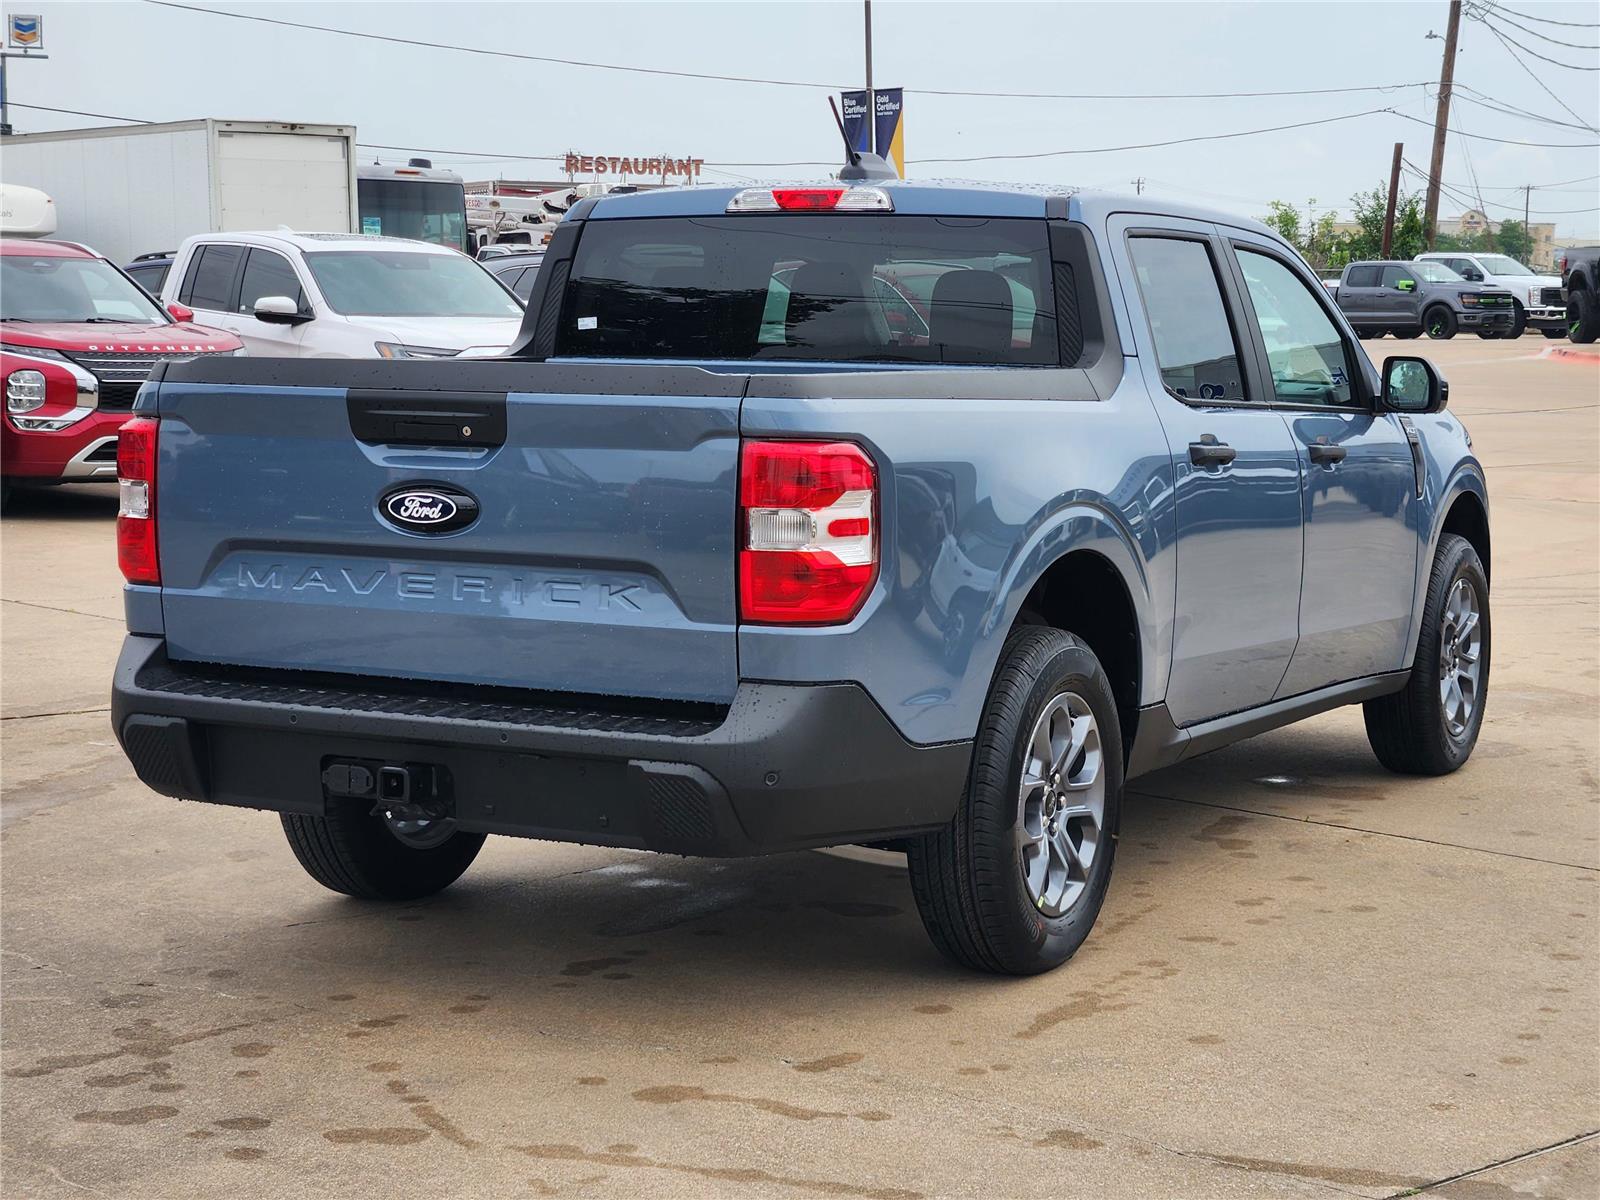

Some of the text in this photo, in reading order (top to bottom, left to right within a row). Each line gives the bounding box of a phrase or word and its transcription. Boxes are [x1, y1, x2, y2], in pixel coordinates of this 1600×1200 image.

[843, 98, 857, 106] Blue
[876, 95, 889, 103] Gold
[844, 105, 867, 114] Certified
[876, 102, 900, 111] Certified
[564, 155, 704, 177] RESTAURANT
[400, 496, 442, 519] Ford
[238, 562, 643, 612] MAVERICK
